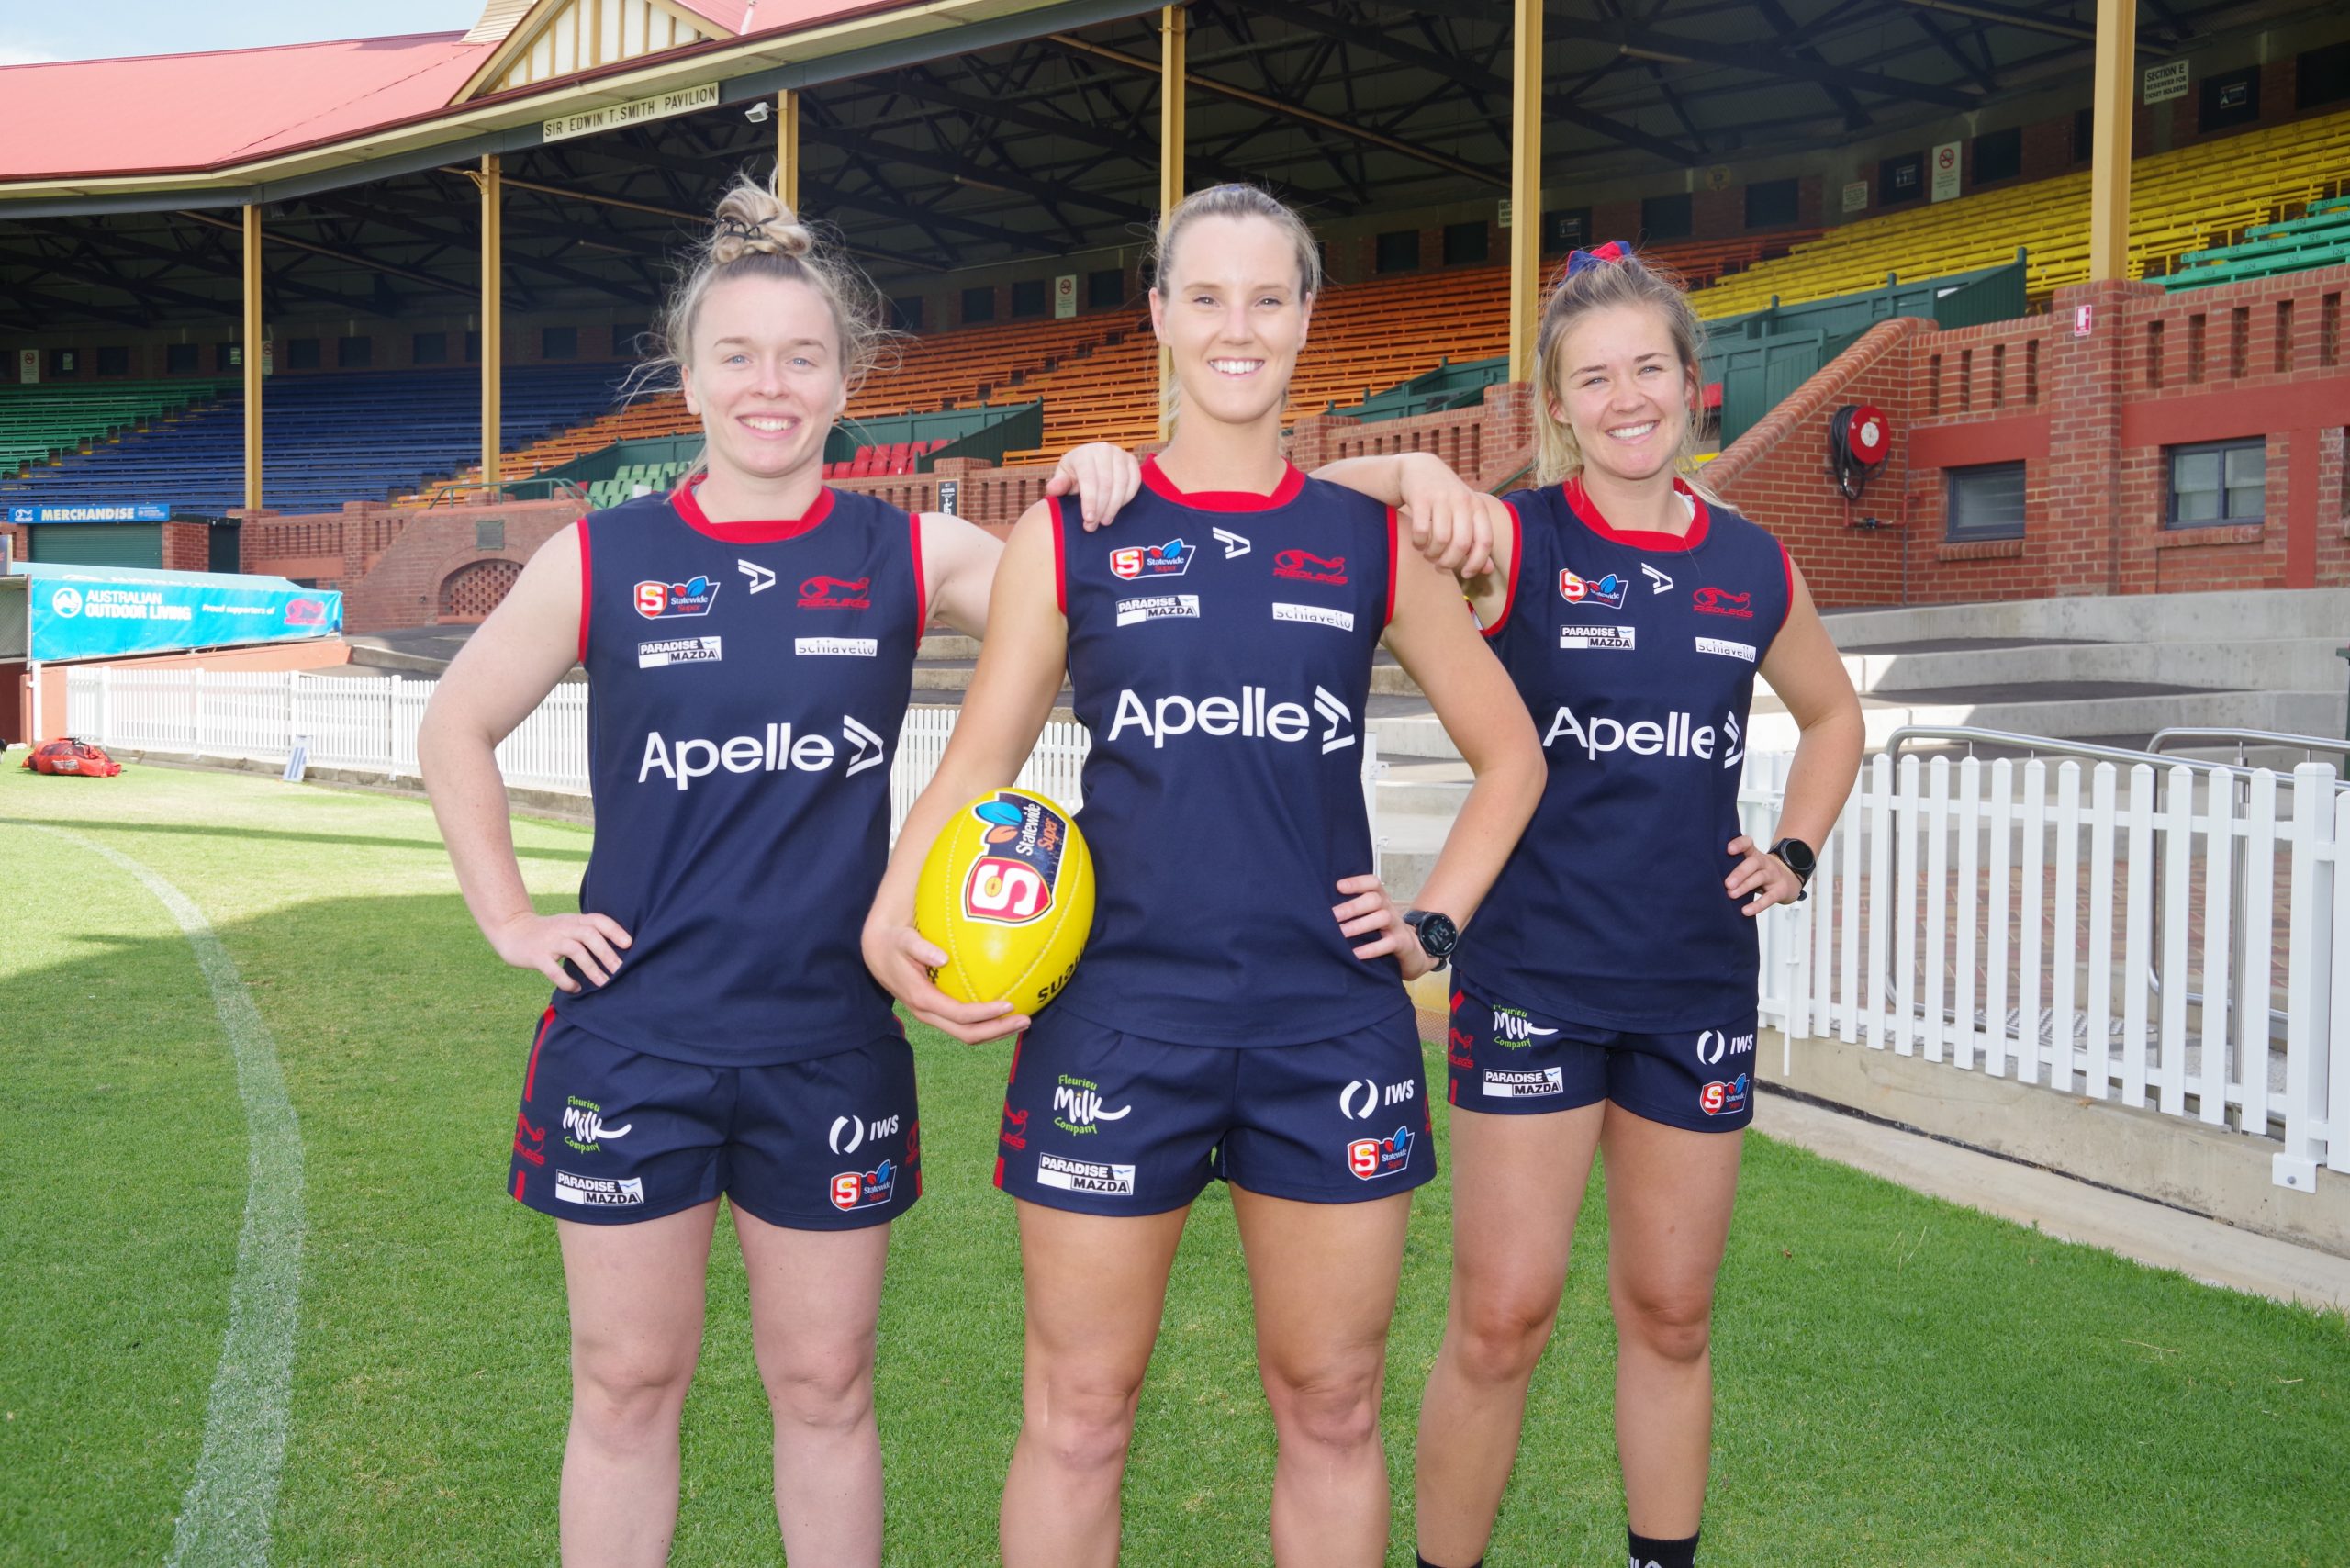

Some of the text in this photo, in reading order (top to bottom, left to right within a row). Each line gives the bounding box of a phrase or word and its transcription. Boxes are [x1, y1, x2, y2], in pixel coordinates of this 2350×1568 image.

[2146, 63, 2185, 82] SECTION E
[2146, 75, 2187, 90] RESERVED FOR
[2145, 84, 2187, 100] TICKET HOLDERS
[545, 121, 563, 137] SIR
[569, 112, 603, 131] EDWIN
[664, 86, 716, 111] PAVILION
[41, 508, 135, 521] MERCHANDISE
[1147, 555, 1185, 566] Statewide
[1154, 565, 1178, 573] Super
[1272, 567, 1349, 586] REDLEGS
[85, 590, 162, 605] AUSTRALIAN
[670, 594, 709, 606] Statewide
[796, 598, 871, 610] REDLEGS
[1117, 597, 1177, 613] PARADISE
[84, 603, 192, 621] OUTDOOR LIVING
[202, 603, 276, 615] Proud supporters of
[677, 603, 701, 612] Super
[1147, 607, 1194, 618] MAZDA
[1692, 605, 1754, 618] REDLEGS
[1276, 606, 1352, 629] schiavello
[1562, 627, 1616, 637] PARADISE
[640, 640, 699, 655] PARADISE
[798, 640, 875, 655] schiavello
[1589, 638, 1631, 648] MAZDA
[1698, 641, 1754, 661] schiavello
[670, 649, 717, 661] MAZDA
[1107, 685, 1310, 749] Apelle
[1542, 706, 1716, 761] Apelle
[638, 722, 835, 791] Apelle
[1015, 803, 1042, 857] Statewide
[1037, 816, 1060, 852] Super
[1494, 1011, 1559, 1040] Milk
[1494, 1036, 1532, 1051] Company
[1729, 1033, 1754, 1055] IWS
[1058, 1073, 1098, 1092] Fleurieu
[1485, 1070, 1543, 1083] PARADISE
[1384, 1079, 1415, 1106] IWS
[1515, 1081, 1560, 1094] MAZDA
[567, 1095, 601, 1112] Fleurieu
[1053, 1084, 1132, 1126] Milk
[562, 1106, 632, 1143] Milk
[868, 1114, 900, 1143] IWS
[1053, 1116, 1098, 1137] Company
[564, 1135, 602, 1154] Company
[1042, 1156, 1109, 1177] PARADISE
[557, 1171, 616, 1193] PARADISE
[863, 1181, 890, 1195] Statewide
[1073, 1176, 1129, 1193] MAZDA
[586, 1192, 638, 1205] MAZDA
[868, 1192, 887, 1203] Super
